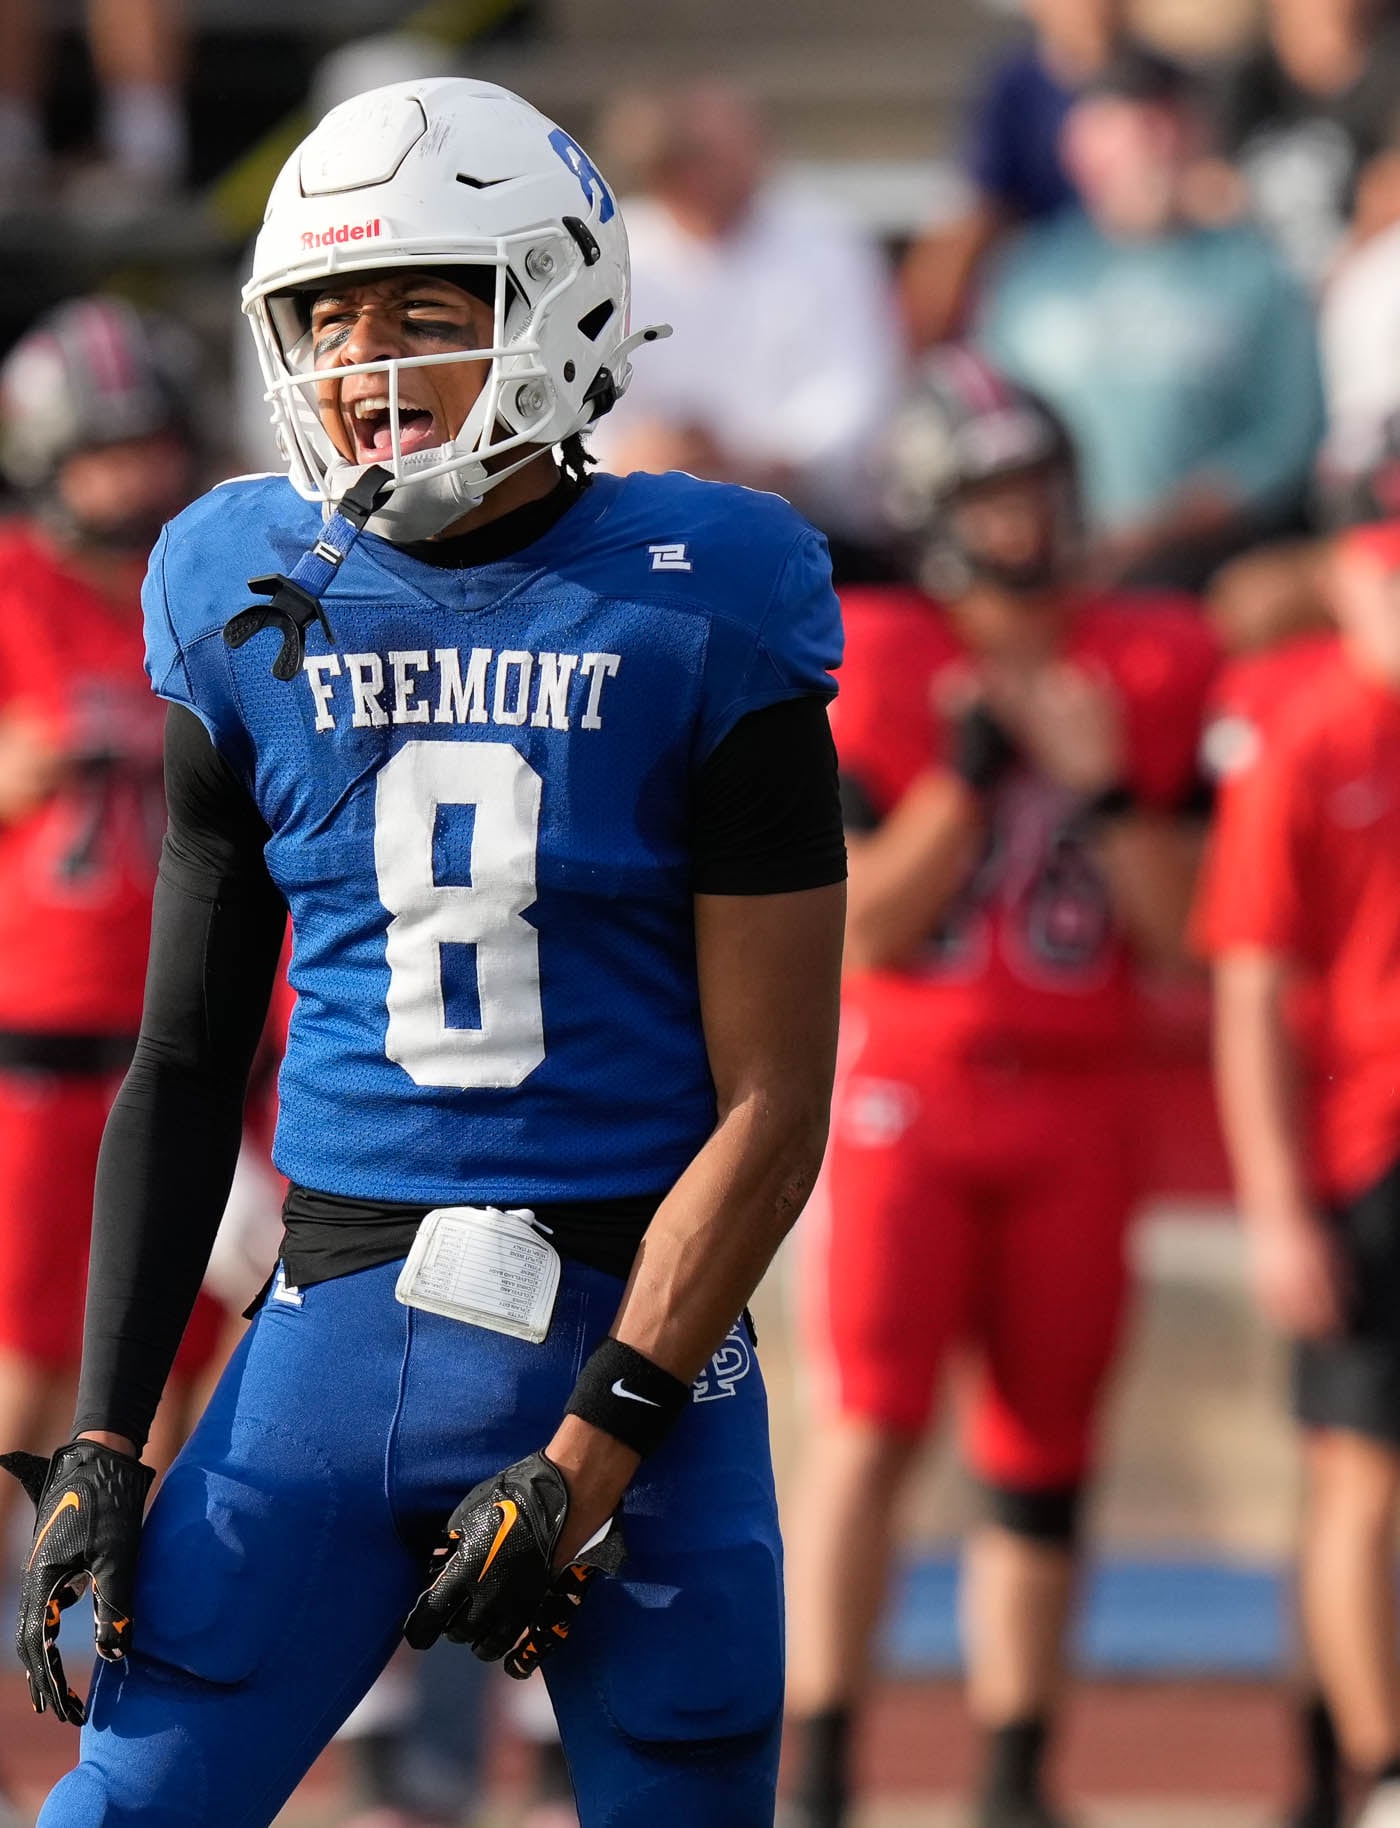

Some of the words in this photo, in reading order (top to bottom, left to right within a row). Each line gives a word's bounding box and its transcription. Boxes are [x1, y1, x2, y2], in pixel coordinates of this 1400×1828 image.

[301, 218, 381, 250] Riddell
[302, 647, 621, 731] FREMONT
[373, 740, 545, 1088] 8
